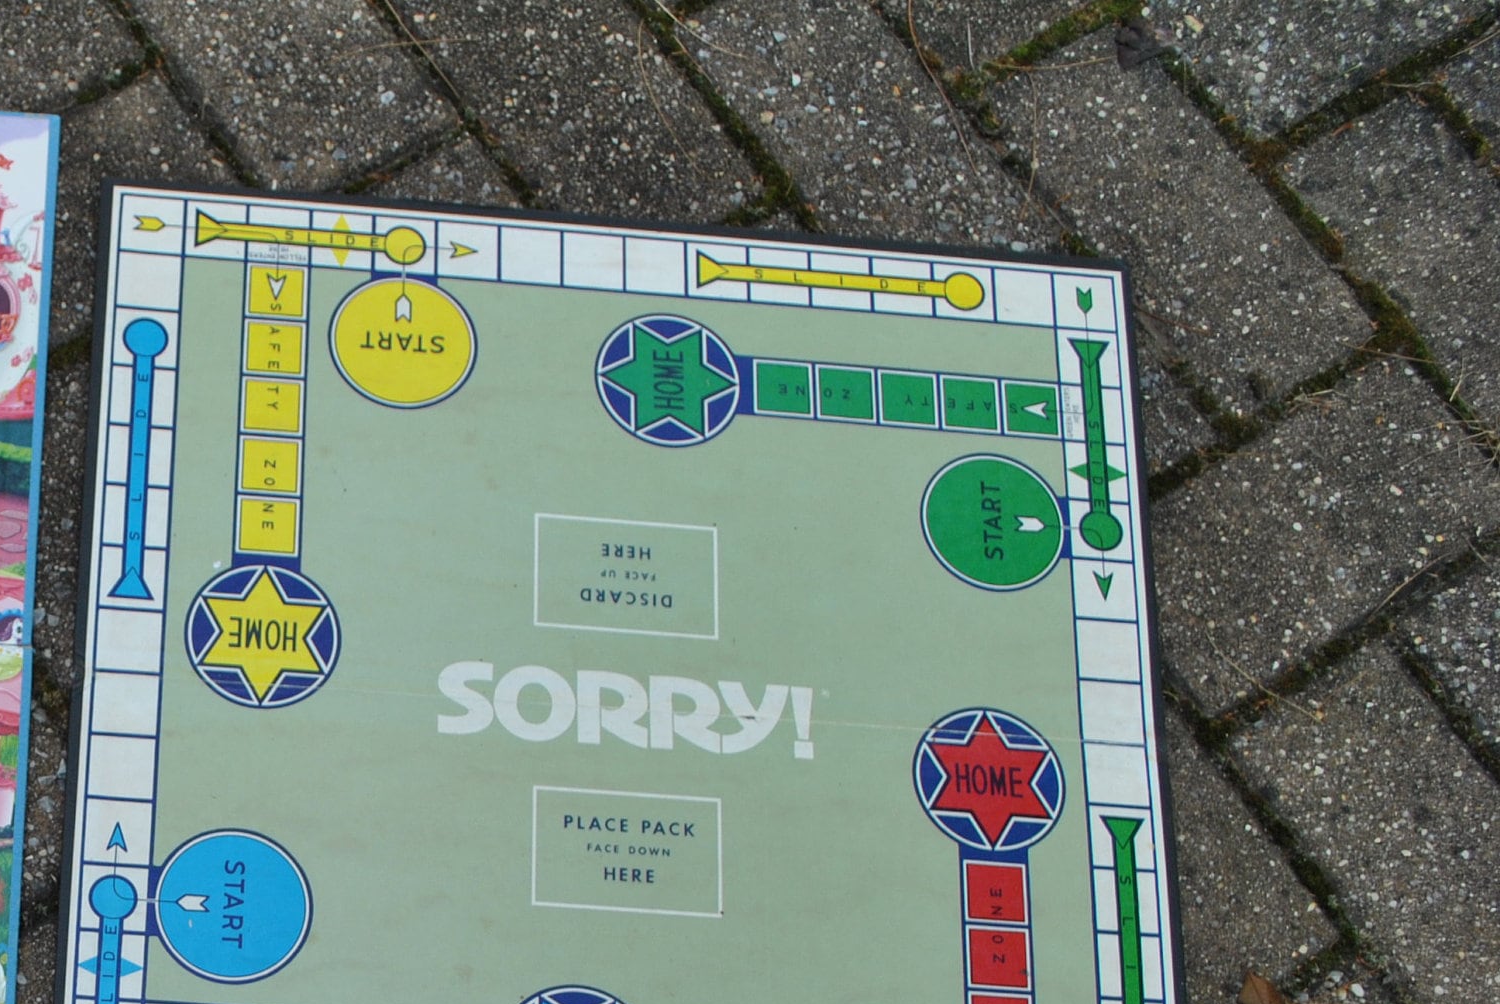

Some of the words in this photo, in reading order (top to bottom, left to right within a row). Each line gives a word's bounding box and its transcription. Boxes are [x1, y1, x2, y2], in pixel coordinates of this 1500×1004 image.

[285, 230, 379, 248] SLIDE
[754, 269, 927, 294] SLIDE
[360, 331, 445, 354] START
[266, 303, 282, 411] SAFETY
[653, 349, 686, 411] HOME
[778, 384, 851, 400] ZONE
[904, 395, 1018, 415] SAFETY
[129, 373, 149, 540] SLIDE
[1088, 421, 1106, 507] SLIDE
[261, 459, 277, 530] ZONE
[983, 481, 1004, 560] START
[601, 543, 652, 560] HERE
[600, 569, 616, 579] UP
[625, 571, 656, 582] FACE
[579, 587, 673, 608] DISCARD
[228, 617, 298, 653] HOME
[437, 660, 815, 760] SORRY!
[954, 763, 1025, 798] HOME
[563, 814, 629, 833] PLACE
[640, 820, 695, 838] PACK
[586, 843, 619, 854] FACE
[628, 846, 671, 857] DOWN
[603, 867, 655, 884] HERE
[220, 859, 246, 949] START
[990, 888, 1007, 963] ZONE
